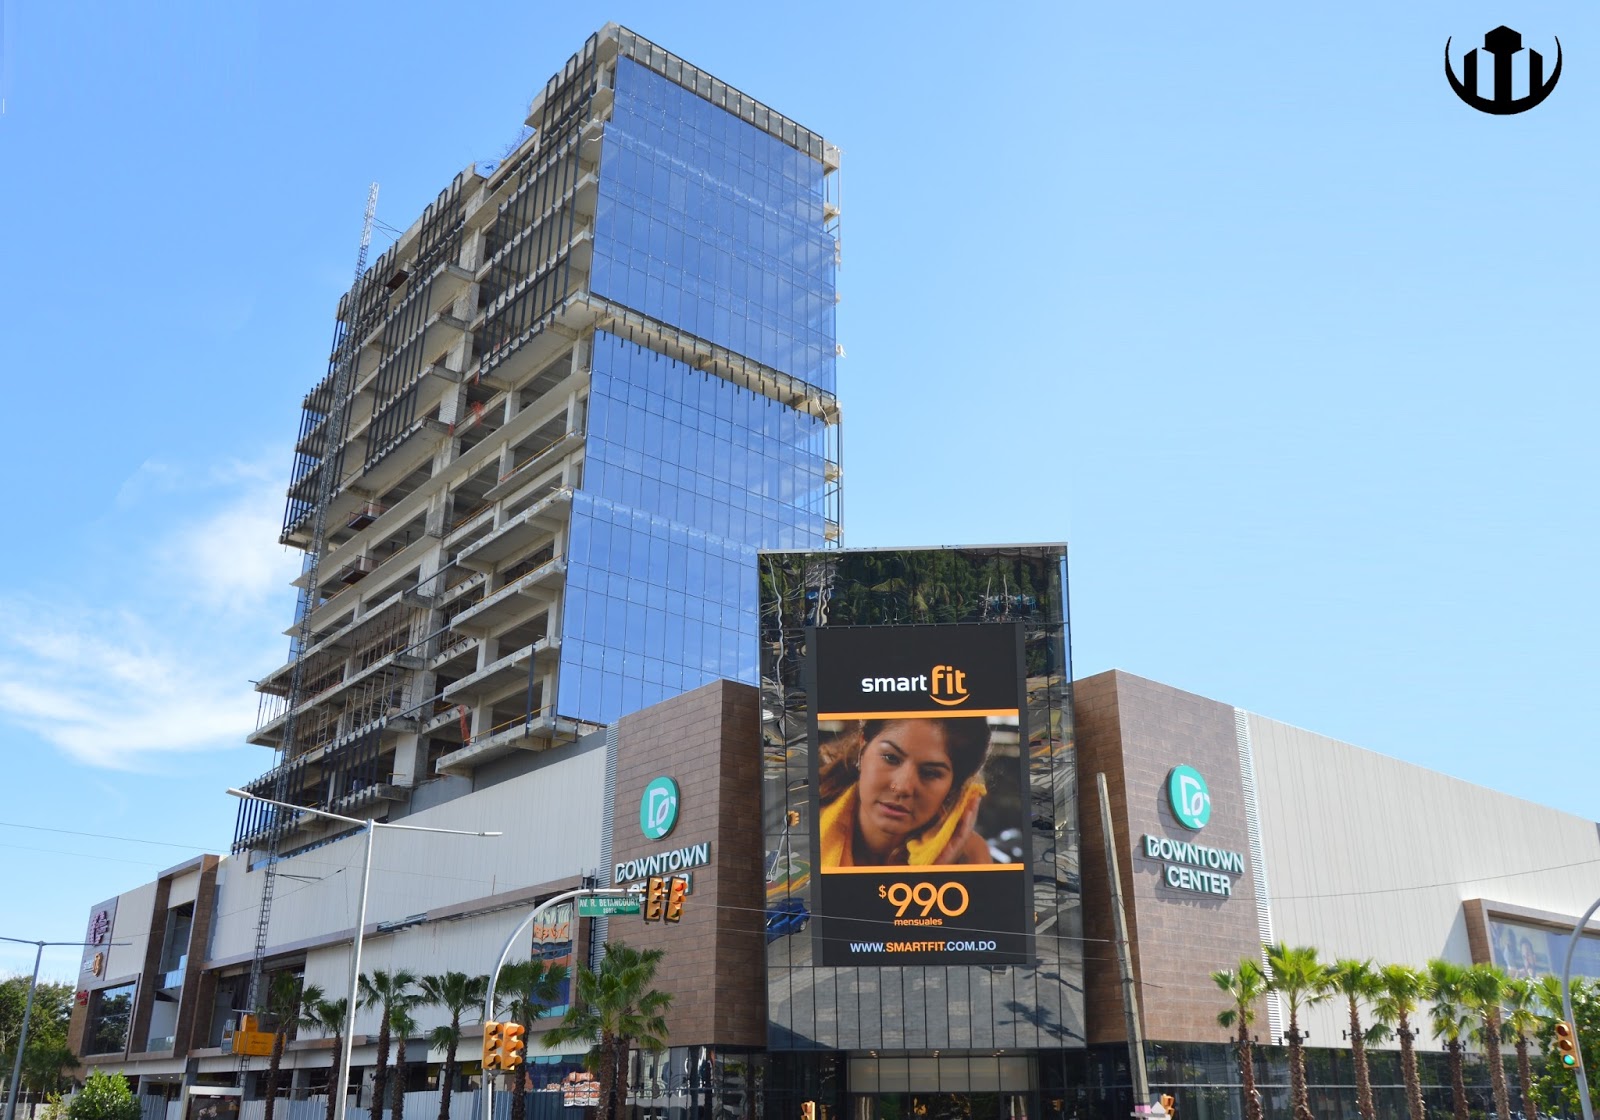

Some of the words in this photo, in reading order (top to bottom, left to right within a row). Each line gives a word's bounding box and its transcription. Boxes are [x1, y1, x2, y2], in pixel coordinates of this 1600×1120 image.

[861, 674, 928, 693] smart
[931, 664, 968, 695] fit
[614, 842, 709, 884] DOWNTOWN
[1144, 834, 1246, 874] DOWNTOWN
[1166, 864, 1232, 896] CENTER
[893, 916, 943, 927] mensuales
[849, 940, 997, 953] WWW.SMARTFIT.COM.DO
